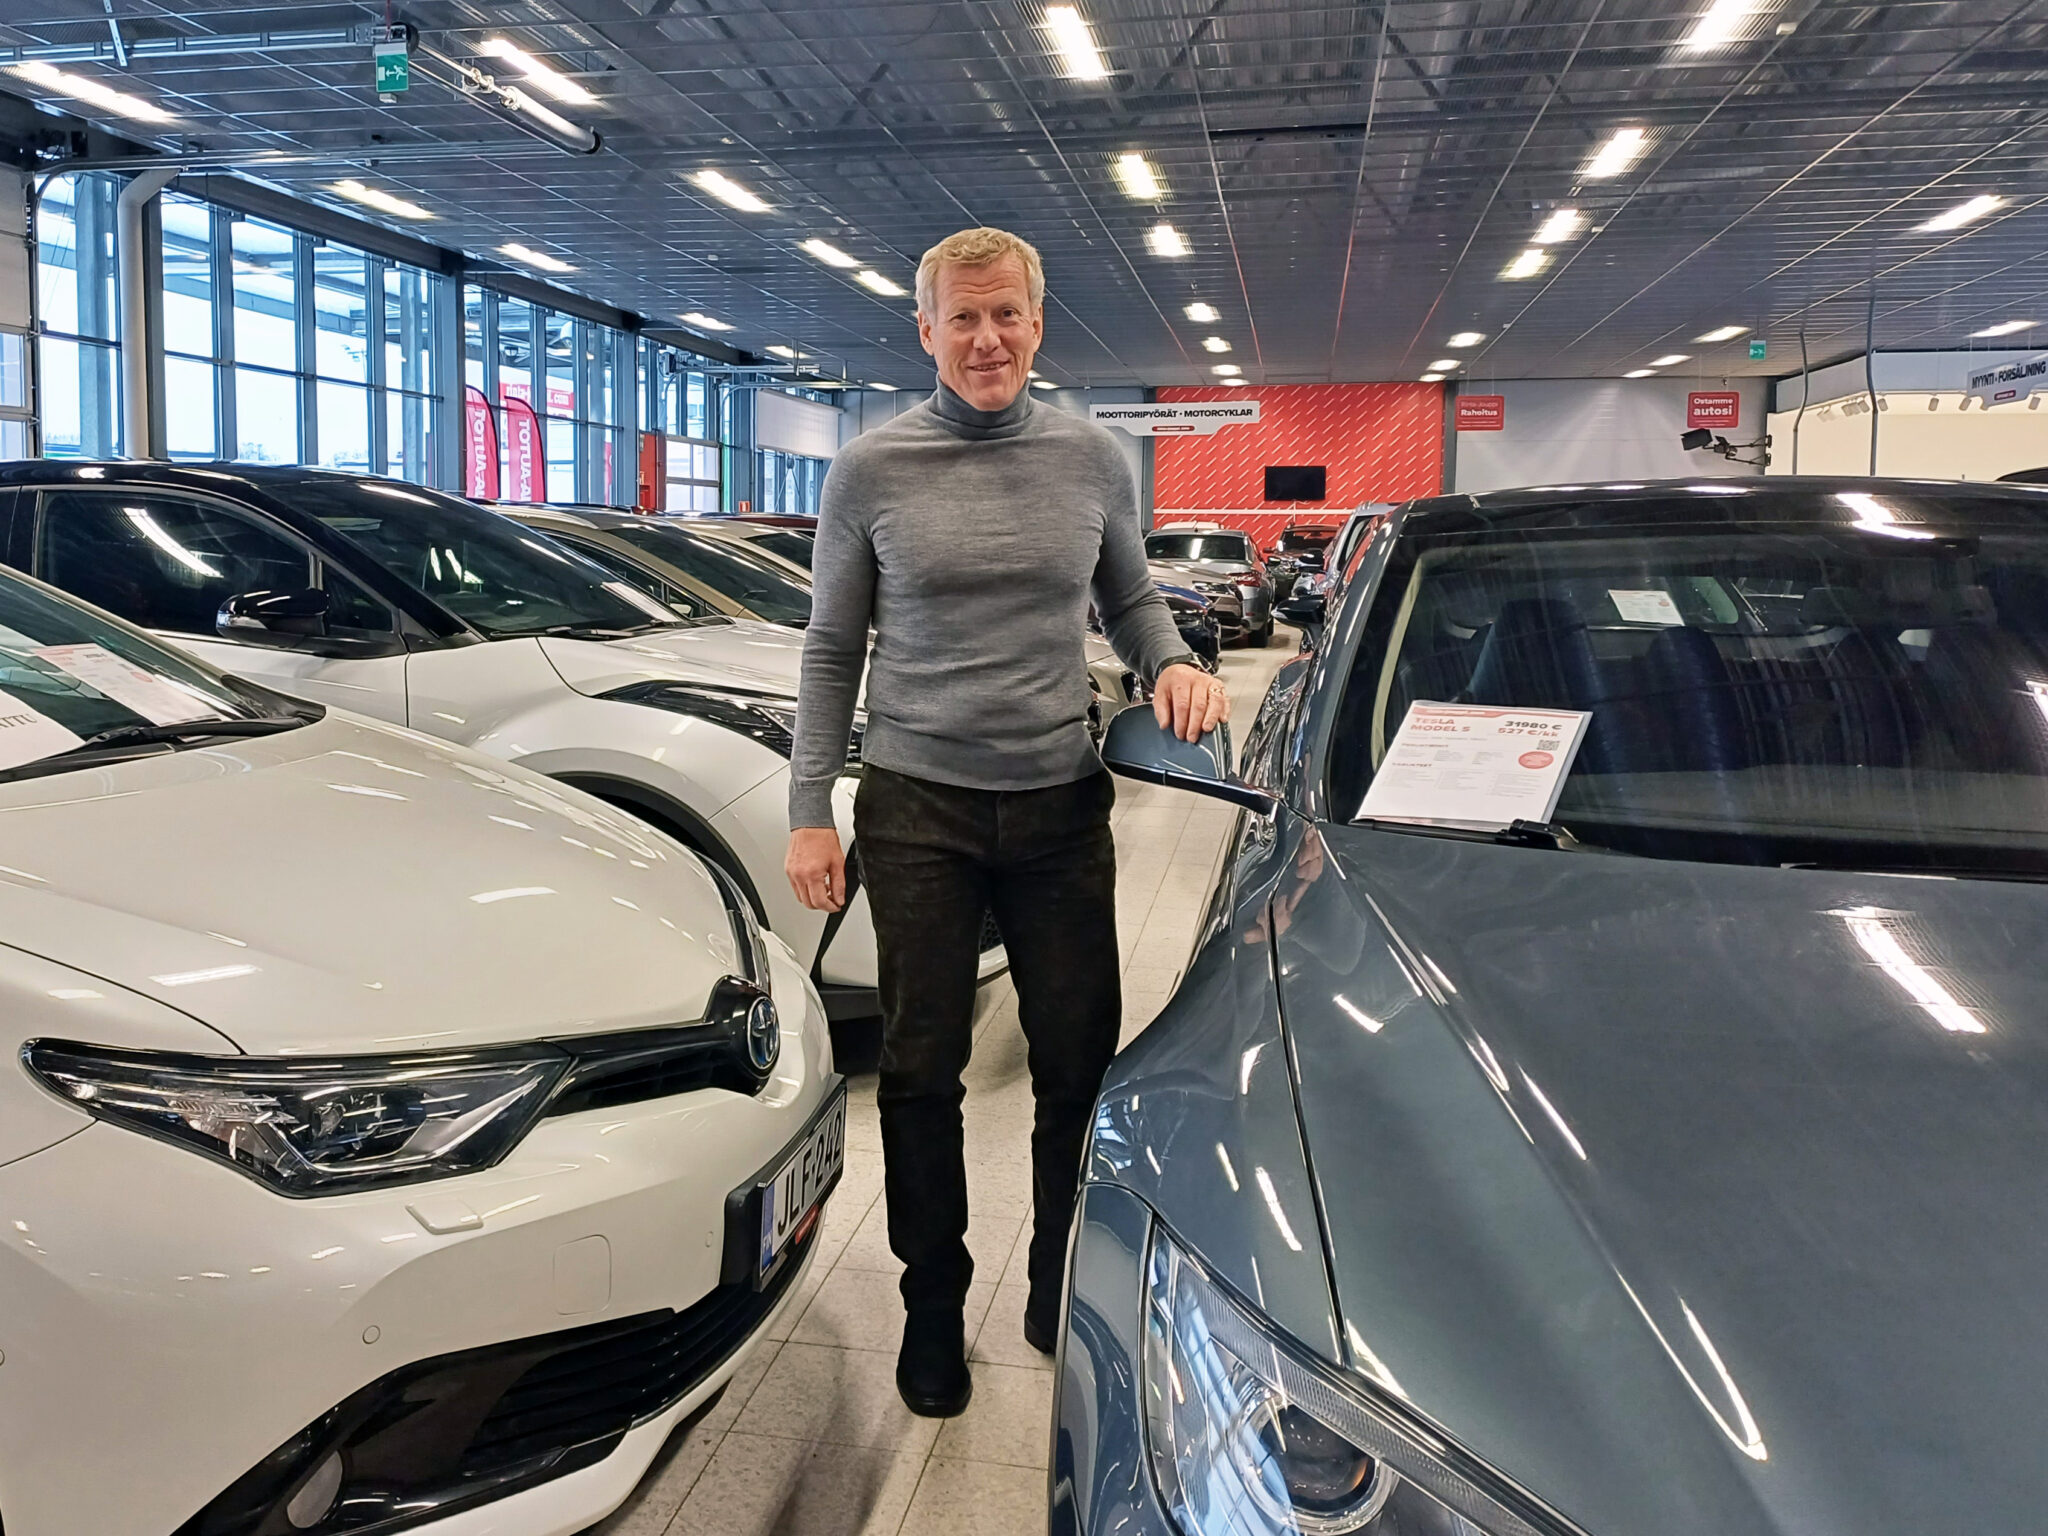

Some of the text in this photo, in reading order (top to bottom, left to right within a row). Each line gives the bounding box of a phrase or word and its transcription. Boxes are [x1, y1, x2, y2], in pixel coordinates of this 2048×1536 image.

[1971, 372, 1995, 389] MYYNTI
[1693, 397, 1734, 405] Ostamme
[1096, 408, 1178, 419] MOOTTORIPYÖRÄT
[1184, 408, 1253, 418] MOTORCYKLAR
[1460, 408, 1498, 417] Rahoitus
[1693, 404, 1733, 416] autosi
[1414, 717, 1455, 725] TESLA
[1504, 720, 1548, 730] 31980
[1410, 724, 1458, 732] MODEL
[777, 1109, 842, 1237] JLF-242
